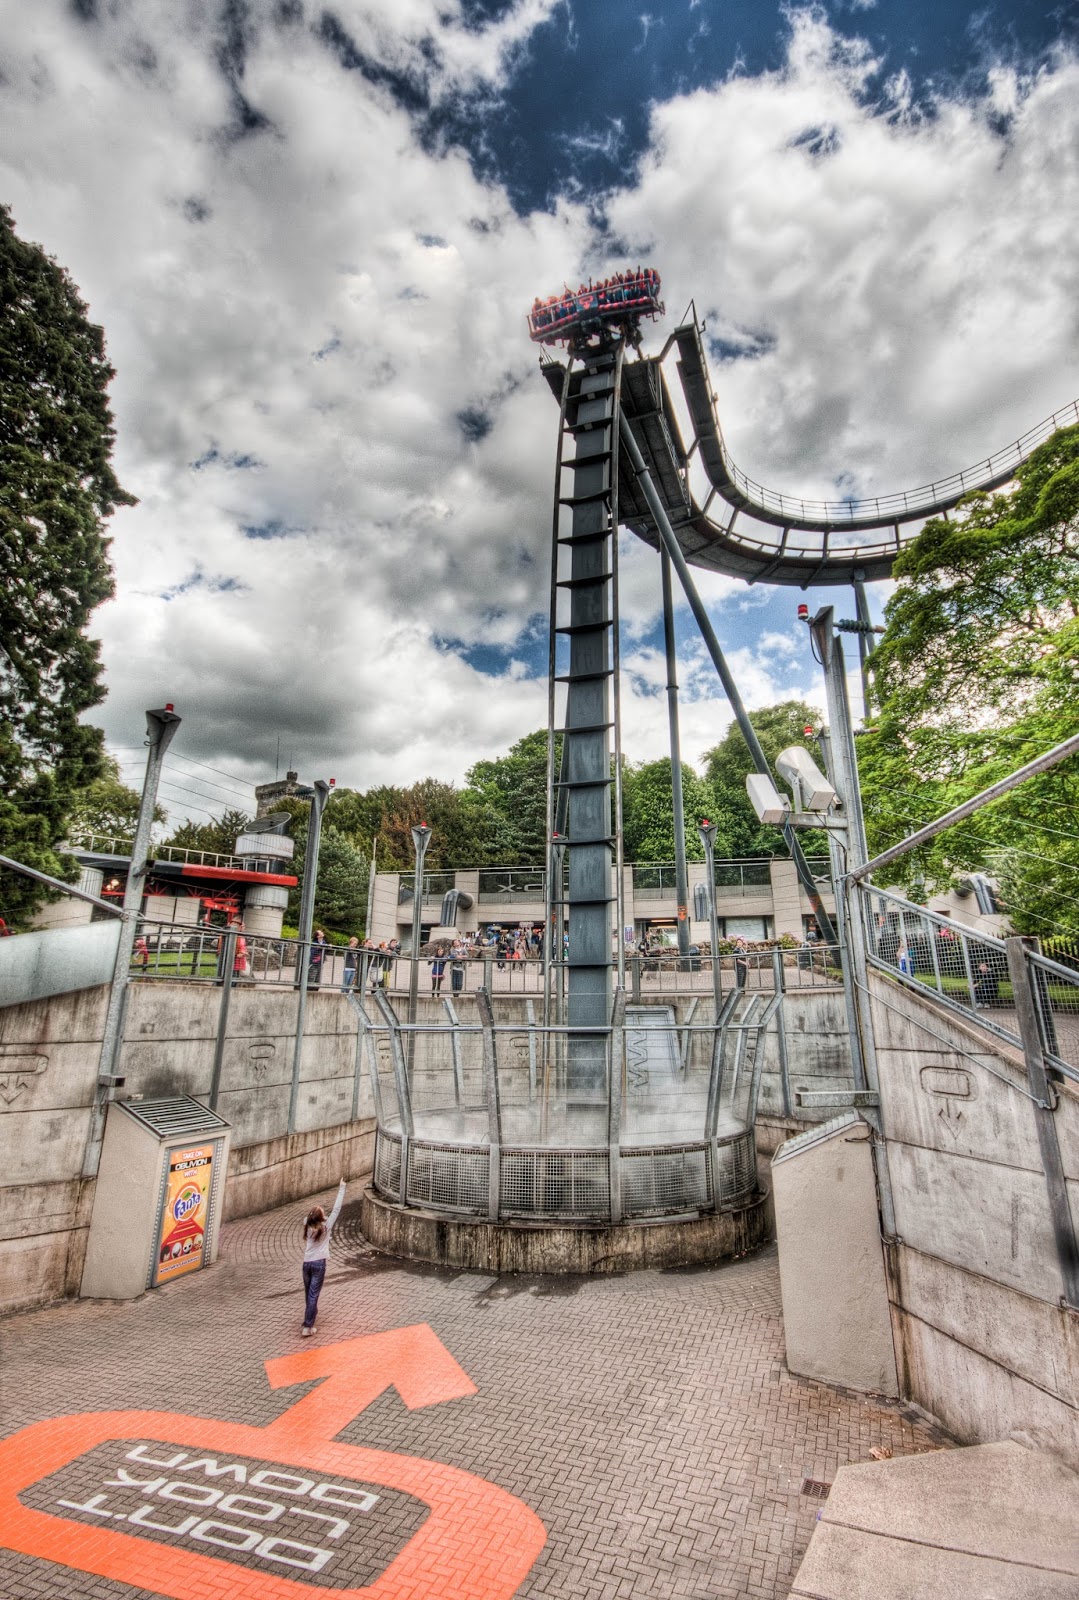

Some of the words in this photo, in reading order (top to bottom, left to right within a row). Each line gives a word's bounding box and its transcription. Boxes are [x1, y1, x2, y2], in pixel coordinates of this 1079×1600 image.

[175, 1157, 207, 1171] OBLIVION
[174, 1192, 201, 1220] Fanta
[103, 1468, 350, 1539] LOOK
[125, 1445, 380, 1512] DOWN
[55, 1494, 335, 1573] DON'T
